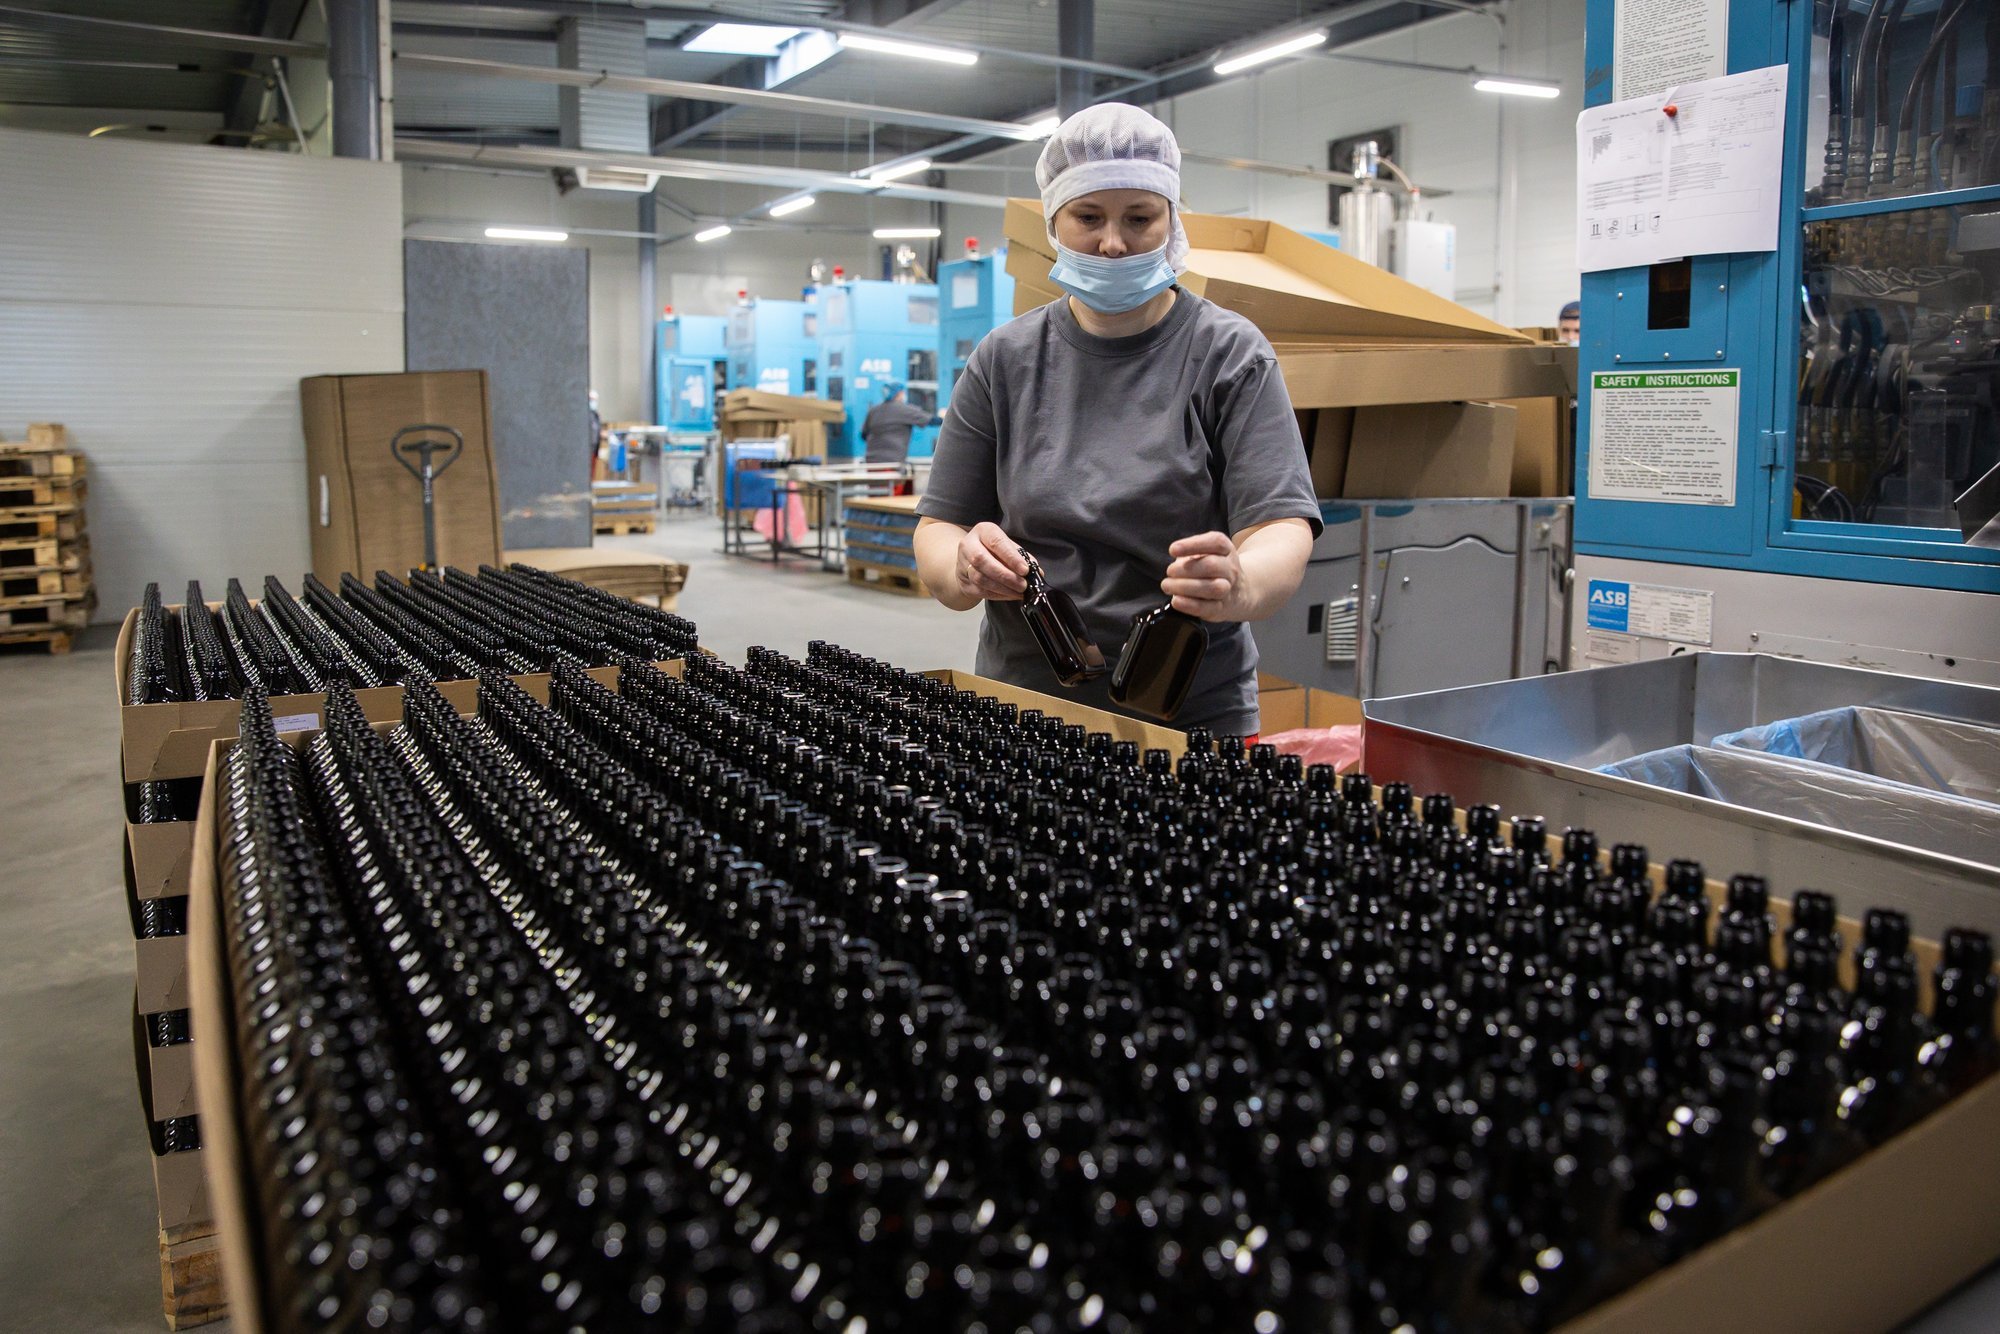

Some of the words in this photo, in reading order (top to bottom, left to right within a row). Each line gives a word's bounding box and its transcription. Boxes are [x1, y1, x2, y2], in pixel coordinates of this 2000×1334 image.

[1600, 376, 1641, 387] SAFETY
[1645, 374, 1730, 386] INSTRUCTIONS
[1590, 589, 1628, 606] ASB
